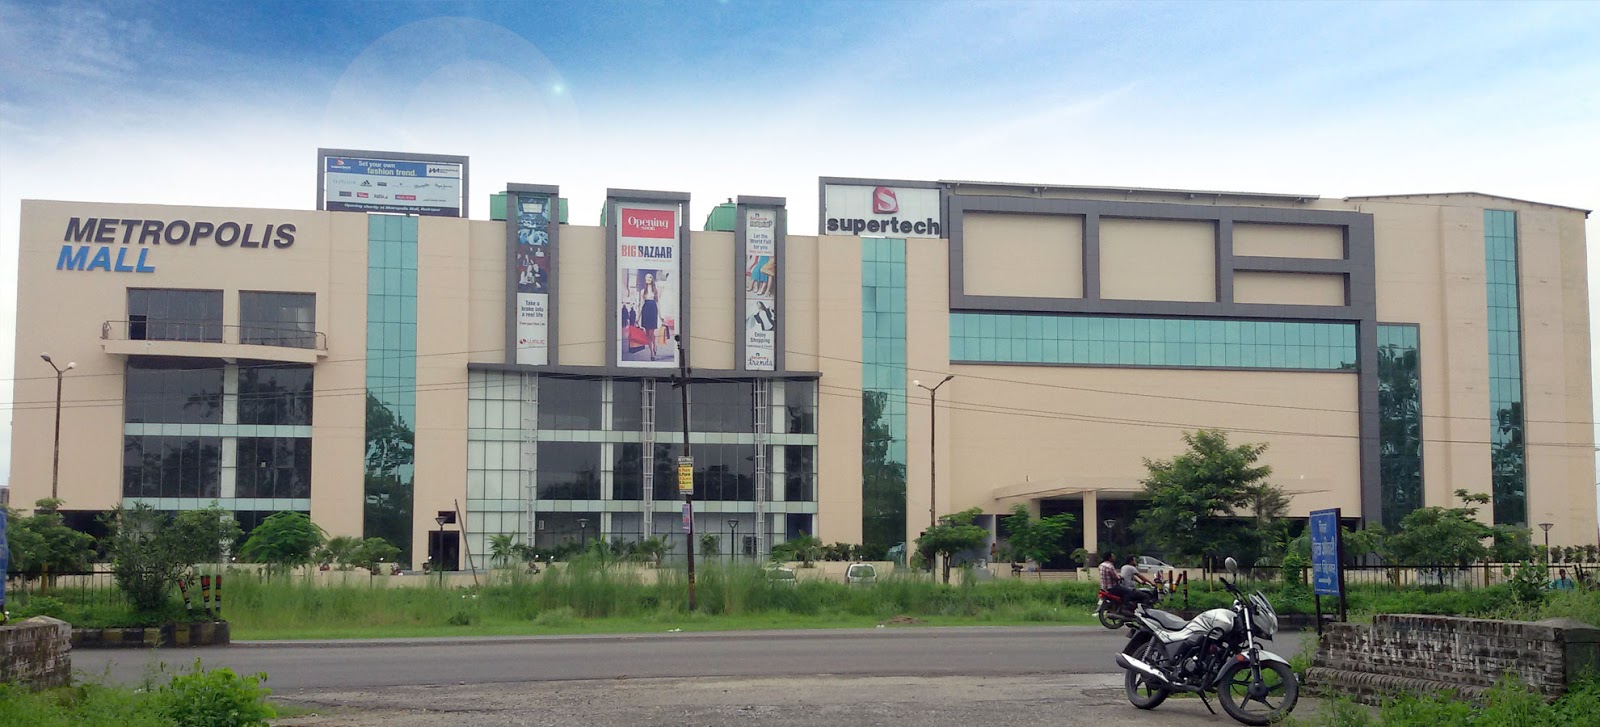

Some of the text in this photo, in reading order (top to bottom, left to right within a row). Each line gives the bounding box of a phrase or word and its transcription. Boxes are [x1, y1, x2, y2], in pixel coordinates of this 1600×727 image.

[367, 168, 417, 177] fashion trend.
[627, 216, 669, 229] Opening
[827, 216, 940, 235] supertech
[64, 217, 297, 249] METROPOLIS
[56, 245, 156, 273] MALL
[621, 245, 673, 259] BIG BAZAAR
